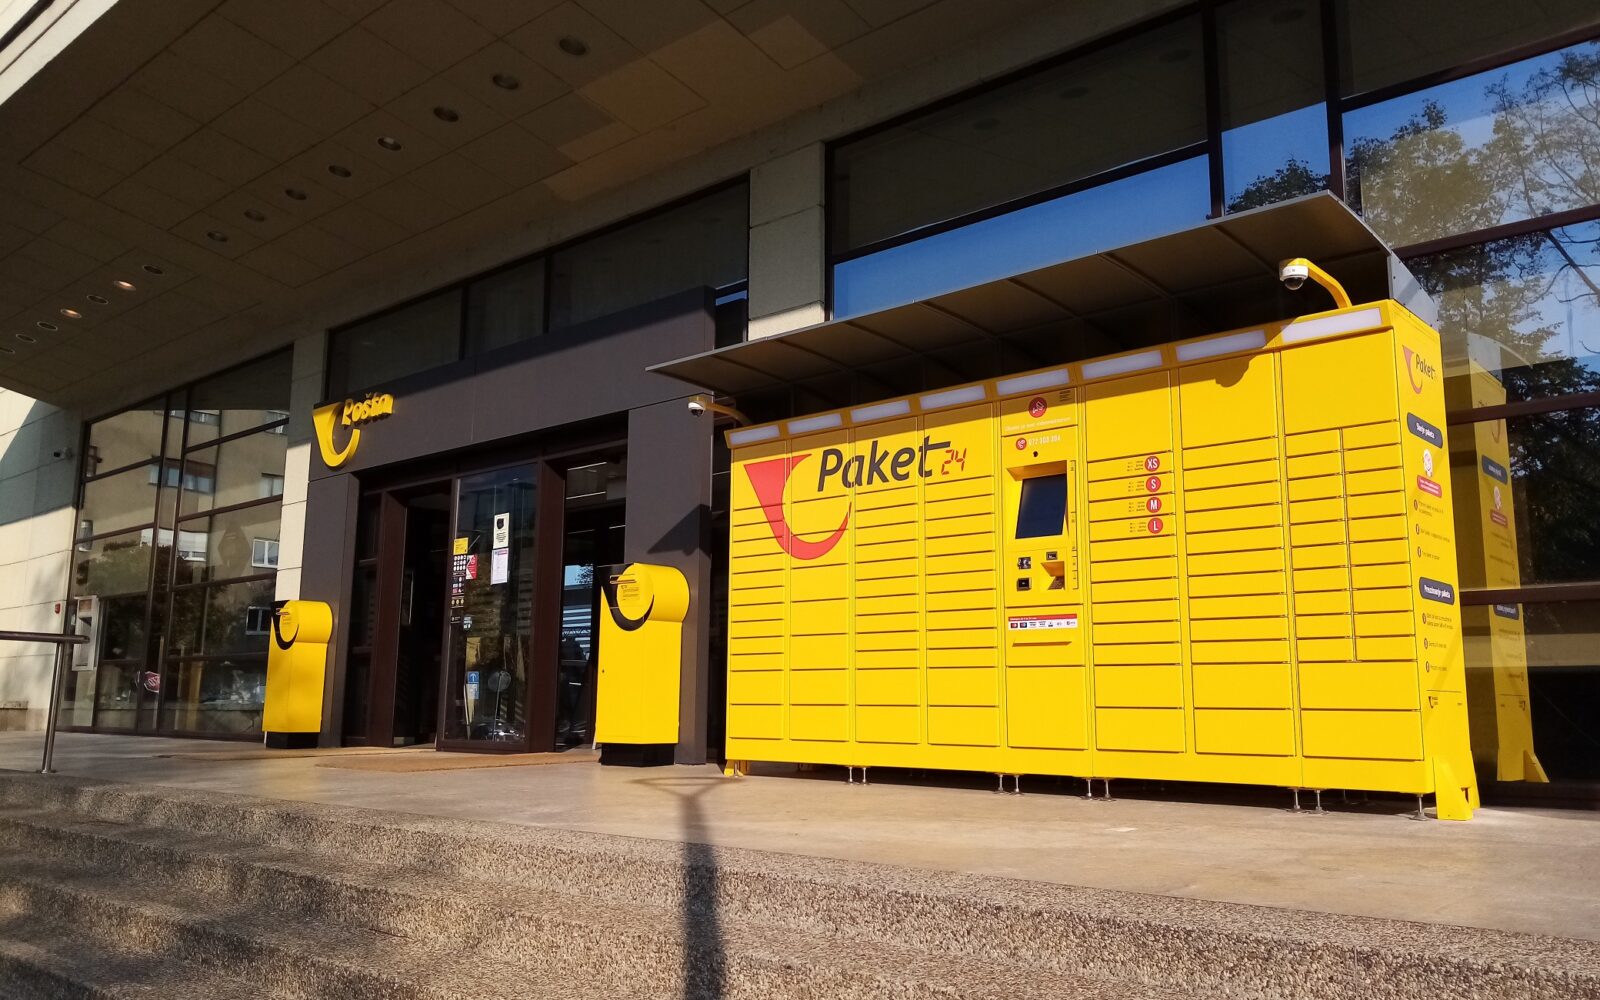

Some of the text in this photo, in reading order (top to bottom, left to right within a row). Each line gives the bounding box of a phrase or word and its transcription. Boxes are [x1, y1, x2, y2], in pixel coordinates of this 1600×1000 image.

[342, 392, 394, 426] Pošta
[817, 435, 967, 492] Paket 24
[1147, 458, 1158, 469] XS
